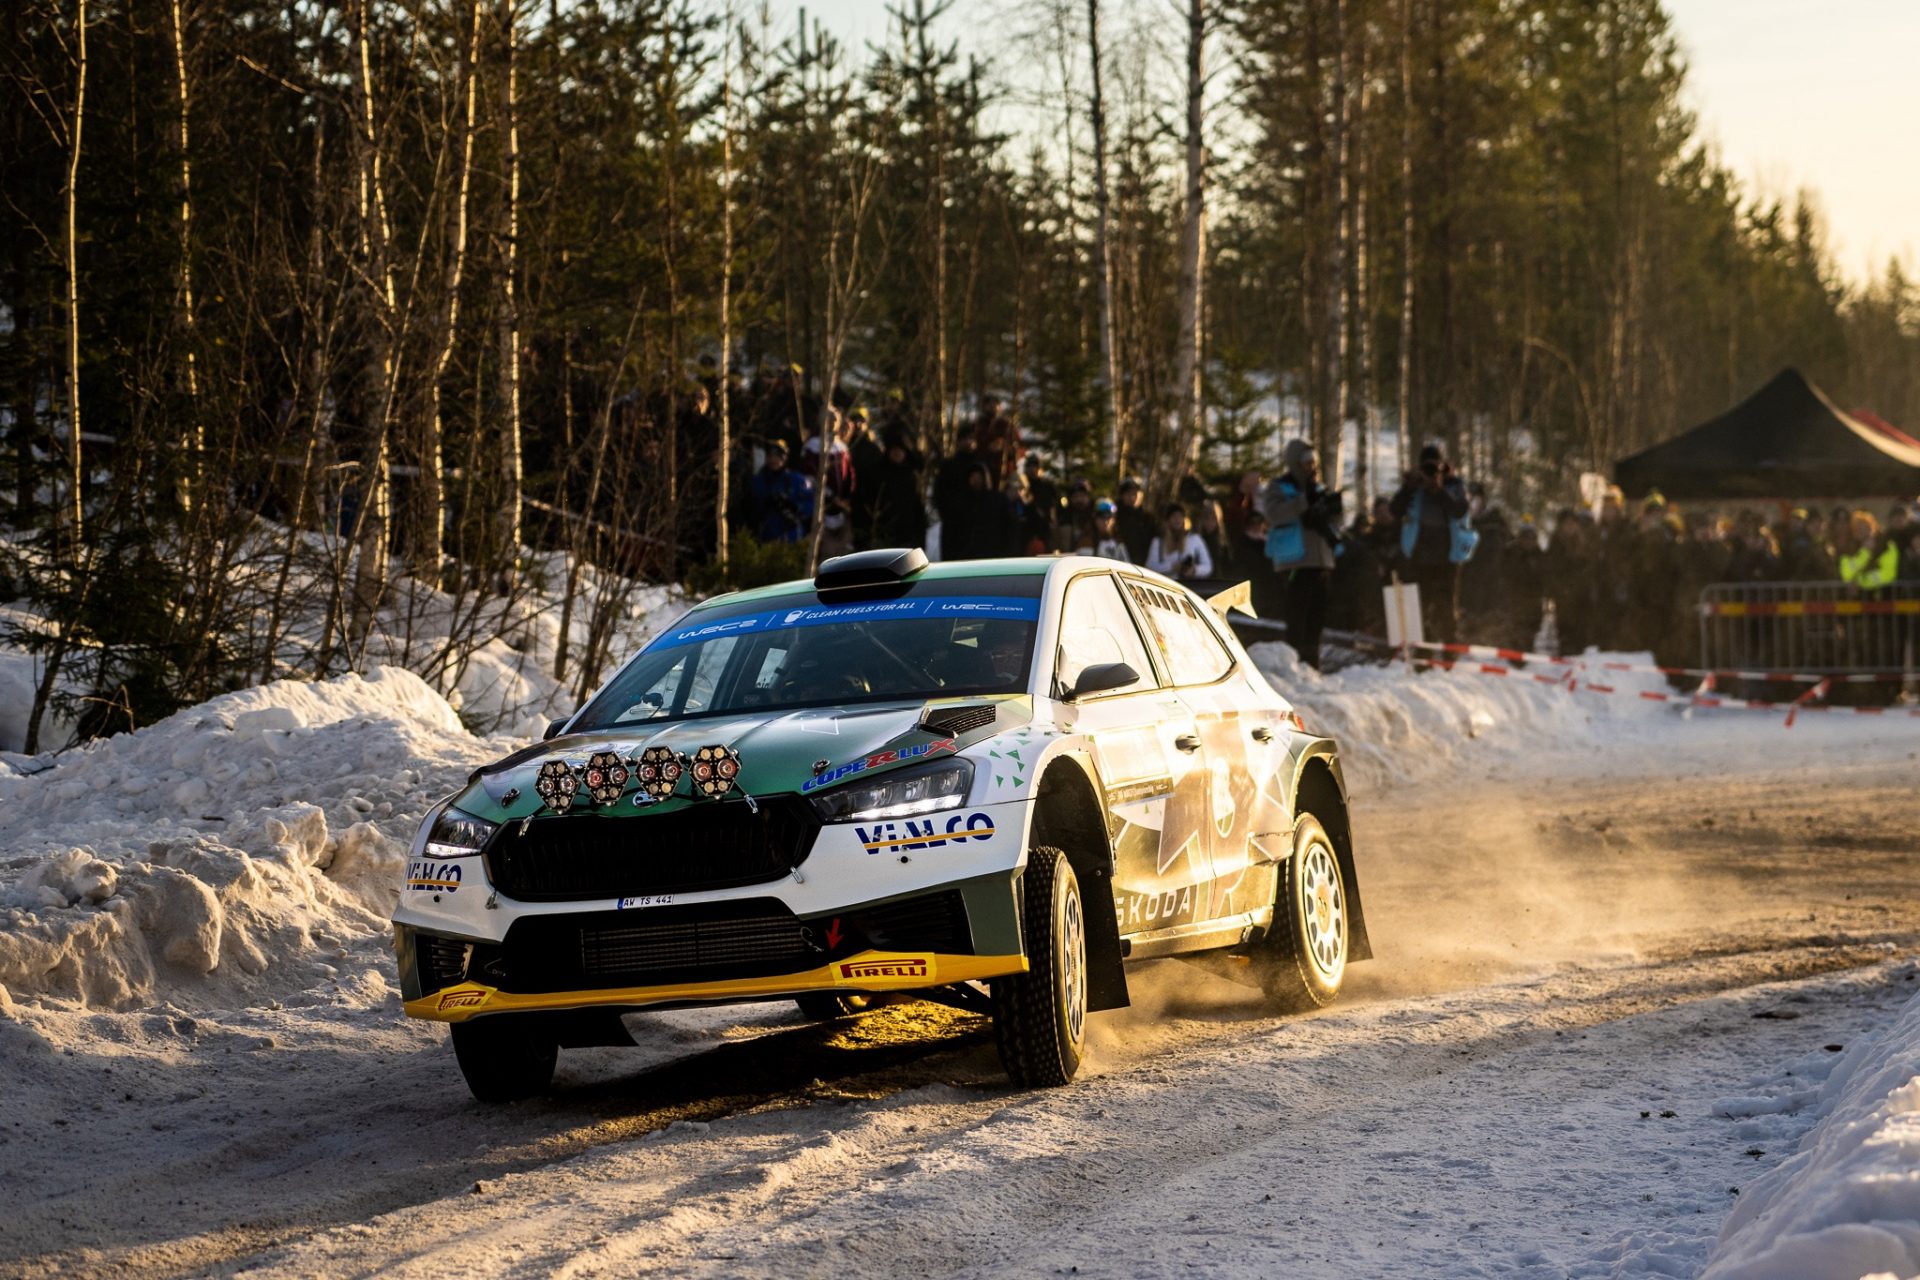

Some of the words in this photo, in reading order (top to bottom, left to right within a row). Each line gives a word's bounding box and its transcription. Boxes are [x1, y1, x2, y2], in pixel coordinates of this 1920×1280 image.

[806, 609, 841, 620] CLEAN
[841, 606, 872, 616] FUELS
[874, 604, 895, 612] FOR
[896, 602, 916, 610] ALL
[678, 619, 757, 640] WRC2
[640, 896, 651, 906] TS
[840, 958, 927, 979] PIRELLI
[438, 990, 487, 1011] PIRELLI
